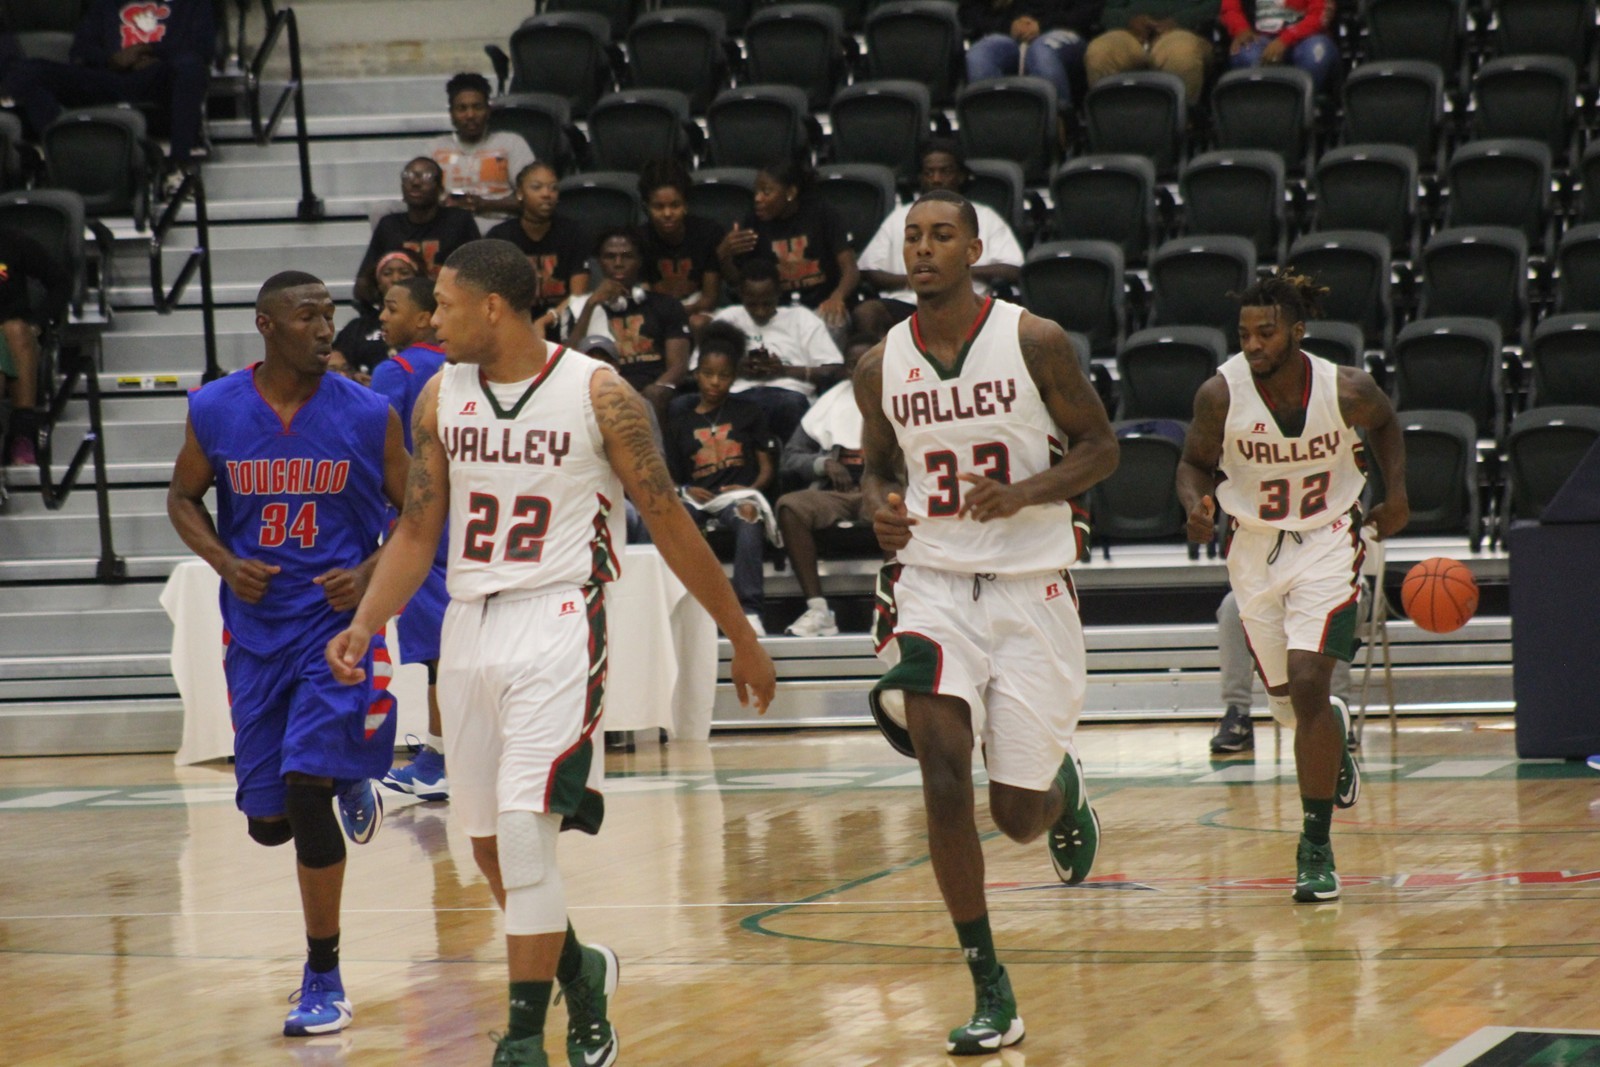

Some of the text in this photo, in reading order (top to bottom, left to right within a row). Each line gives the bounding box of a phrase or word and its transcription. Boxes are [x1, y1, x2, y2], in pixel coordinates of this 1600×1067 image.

[892, 378, 1016, 427] VALLEY
[444, 427, 571, 466] VALLEY
[1236, 430, 1340, 464] VALLEY
[1254, 422, 1266, 431] R
[226, 458, 350, 495] TOUGALOO
[1259, 470, 1331, 522] 32
[259, 501, 319, 548] 34
[462, 492, 552, 563] 22
